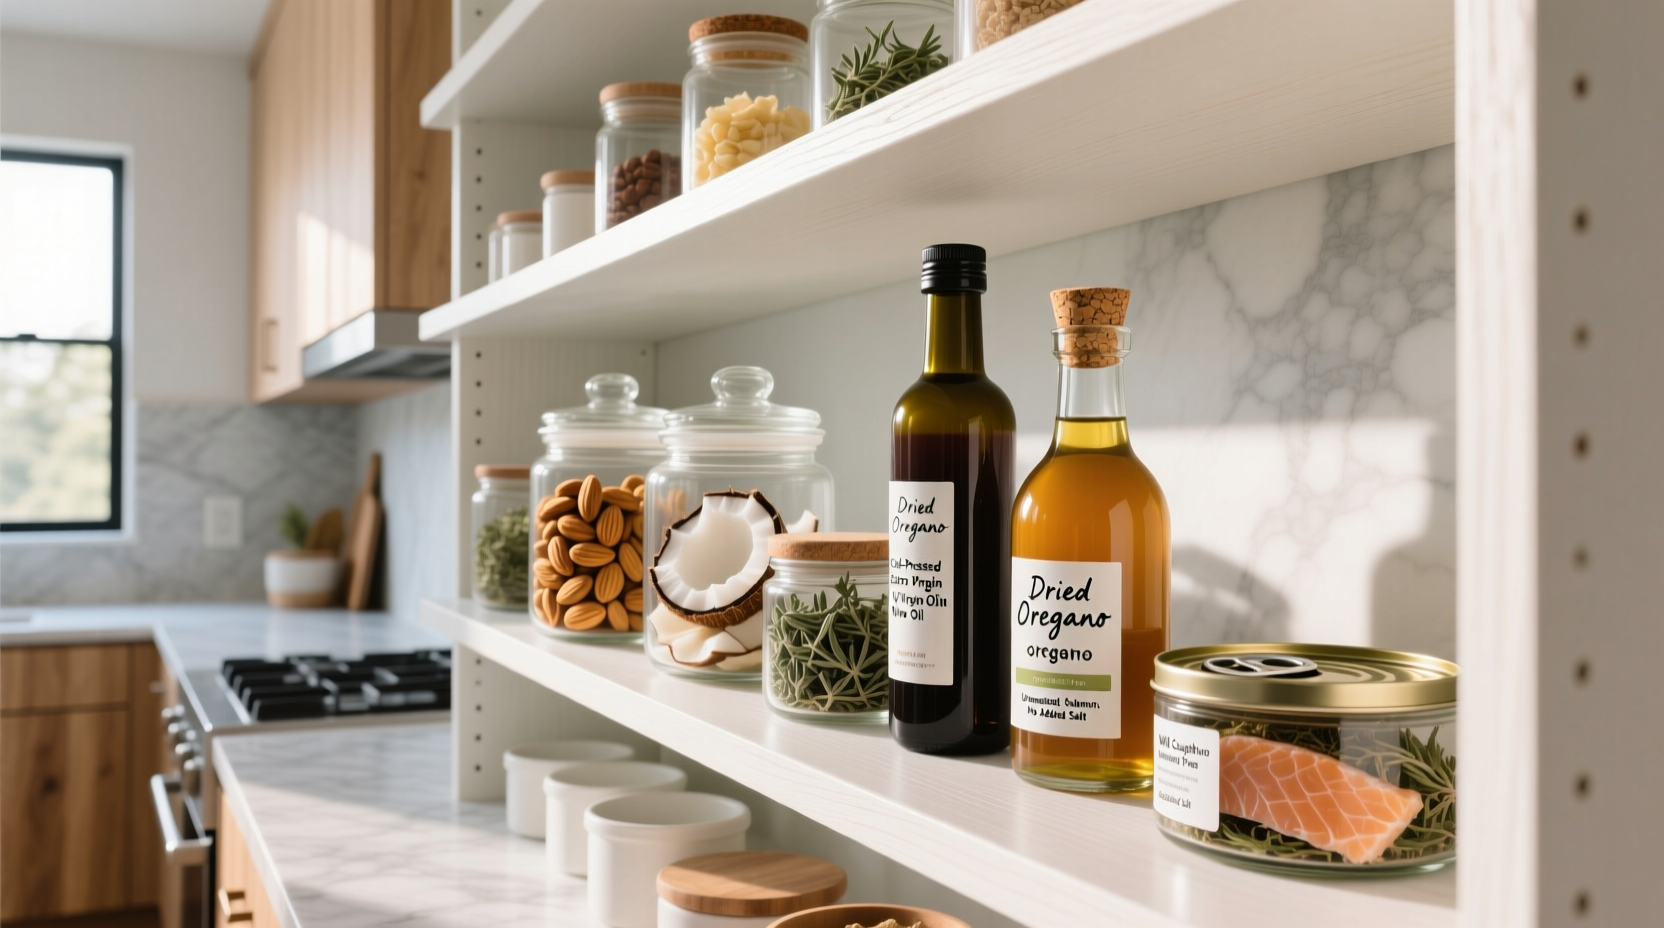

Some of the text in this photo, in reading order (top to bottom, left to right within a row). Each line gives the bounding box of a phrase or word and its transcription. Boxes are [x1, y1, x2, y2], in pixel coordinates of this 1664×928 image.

[898, 496, 936, 514] Dried
[892, 515, 949, 543] Oregano
[1028, 575, 1093, 601] Dried
[1017, 600, 1112, 641] Oregano
[1027, 645, 1093, 664] oregano
[1069, 710, 1087, 721] Salt
